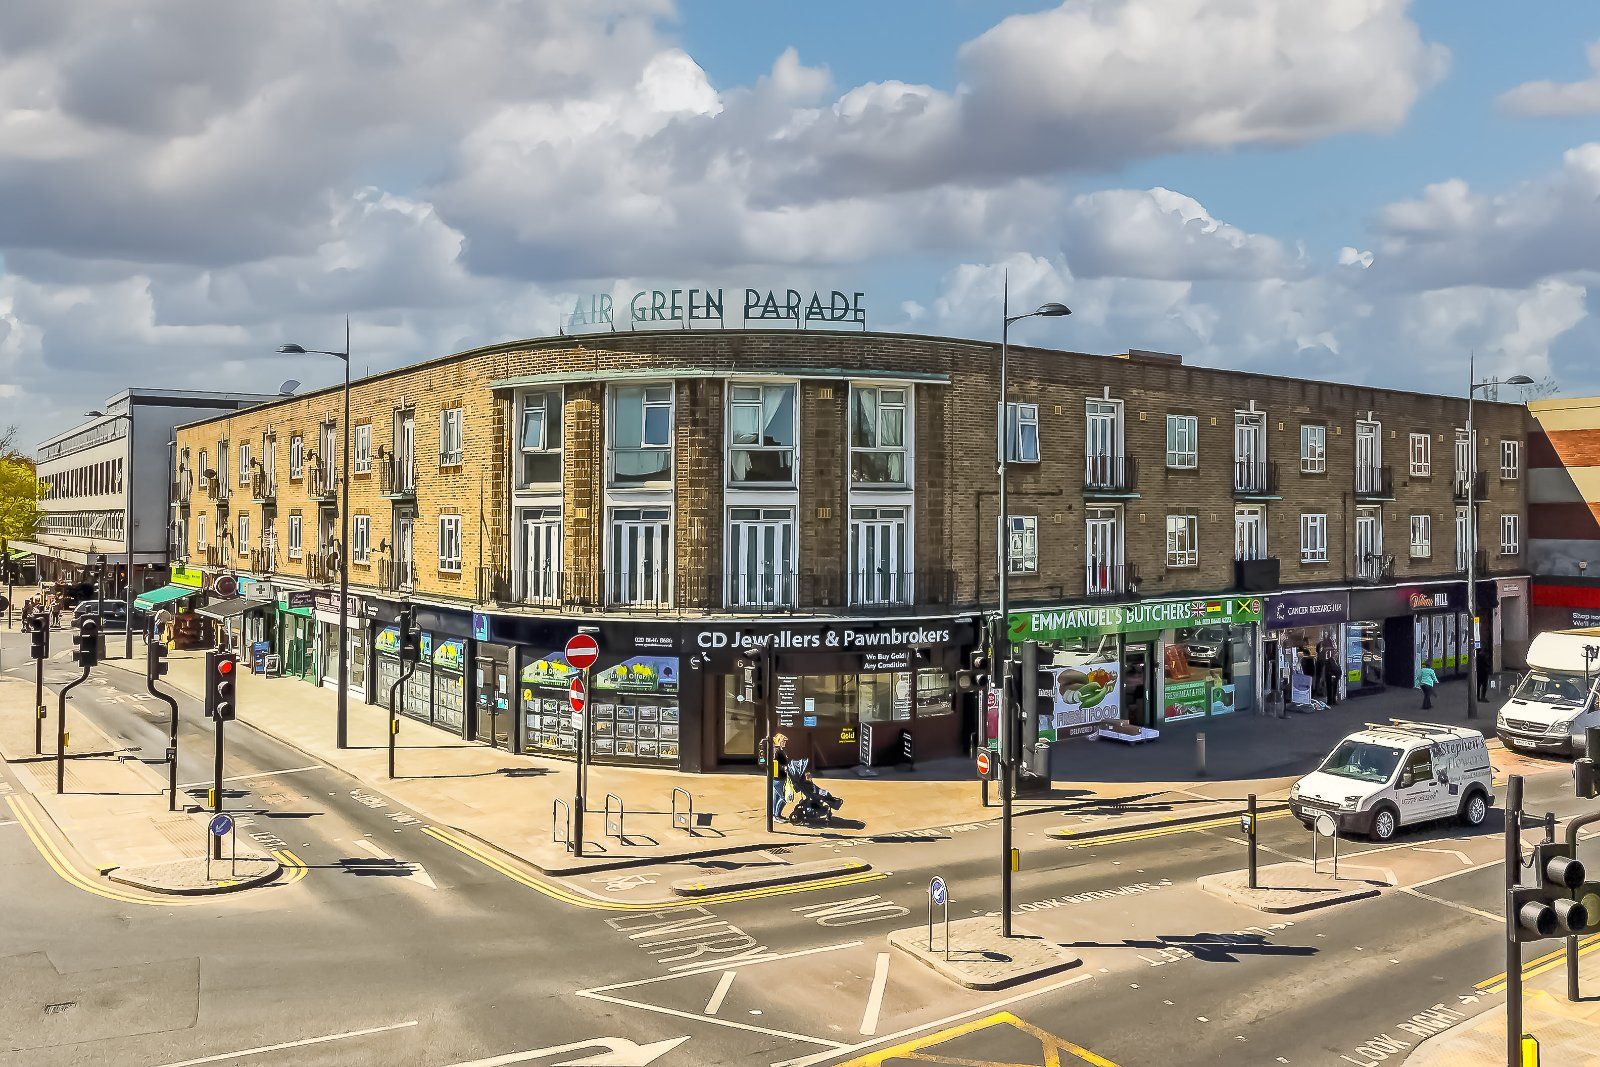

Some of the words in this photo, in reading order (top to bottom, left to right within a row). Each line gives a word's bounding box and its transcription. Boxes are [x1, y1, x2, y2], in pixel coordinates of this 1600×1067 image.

[631, 289, 723, 322] GREEN
[744, 288, 865, 322] PARADE
[1288, 607, 1309, 615] CANCER
[1309, 604, 1335, 613] RESEARCH
[1434, 593, 1448, 606] HILL
[1031, 609, 1123, 632] EMMANUEL'S
[1126, 601, 1191, 624] BUTCHERS
[697, 631, 727, 648] CD
[731, 630, 820, 648] Jewellers
[825, 630, 840, 648] &
[844, 627, 950, 647] Pawnbrokers
[864, 662, 877, 670] Any
[878, 660, 907, 669] Condition
[878, 653, 890, 662] Buy
[890, 652, 905, 660] Gold
[1056, 709, 1087, 728] FRESH
[1088, 704, 1119, 723] FOOD
[1339, 1032, 1411, 1067] LOOK
[1394, 1002, 1466, 1039] RIGHT
